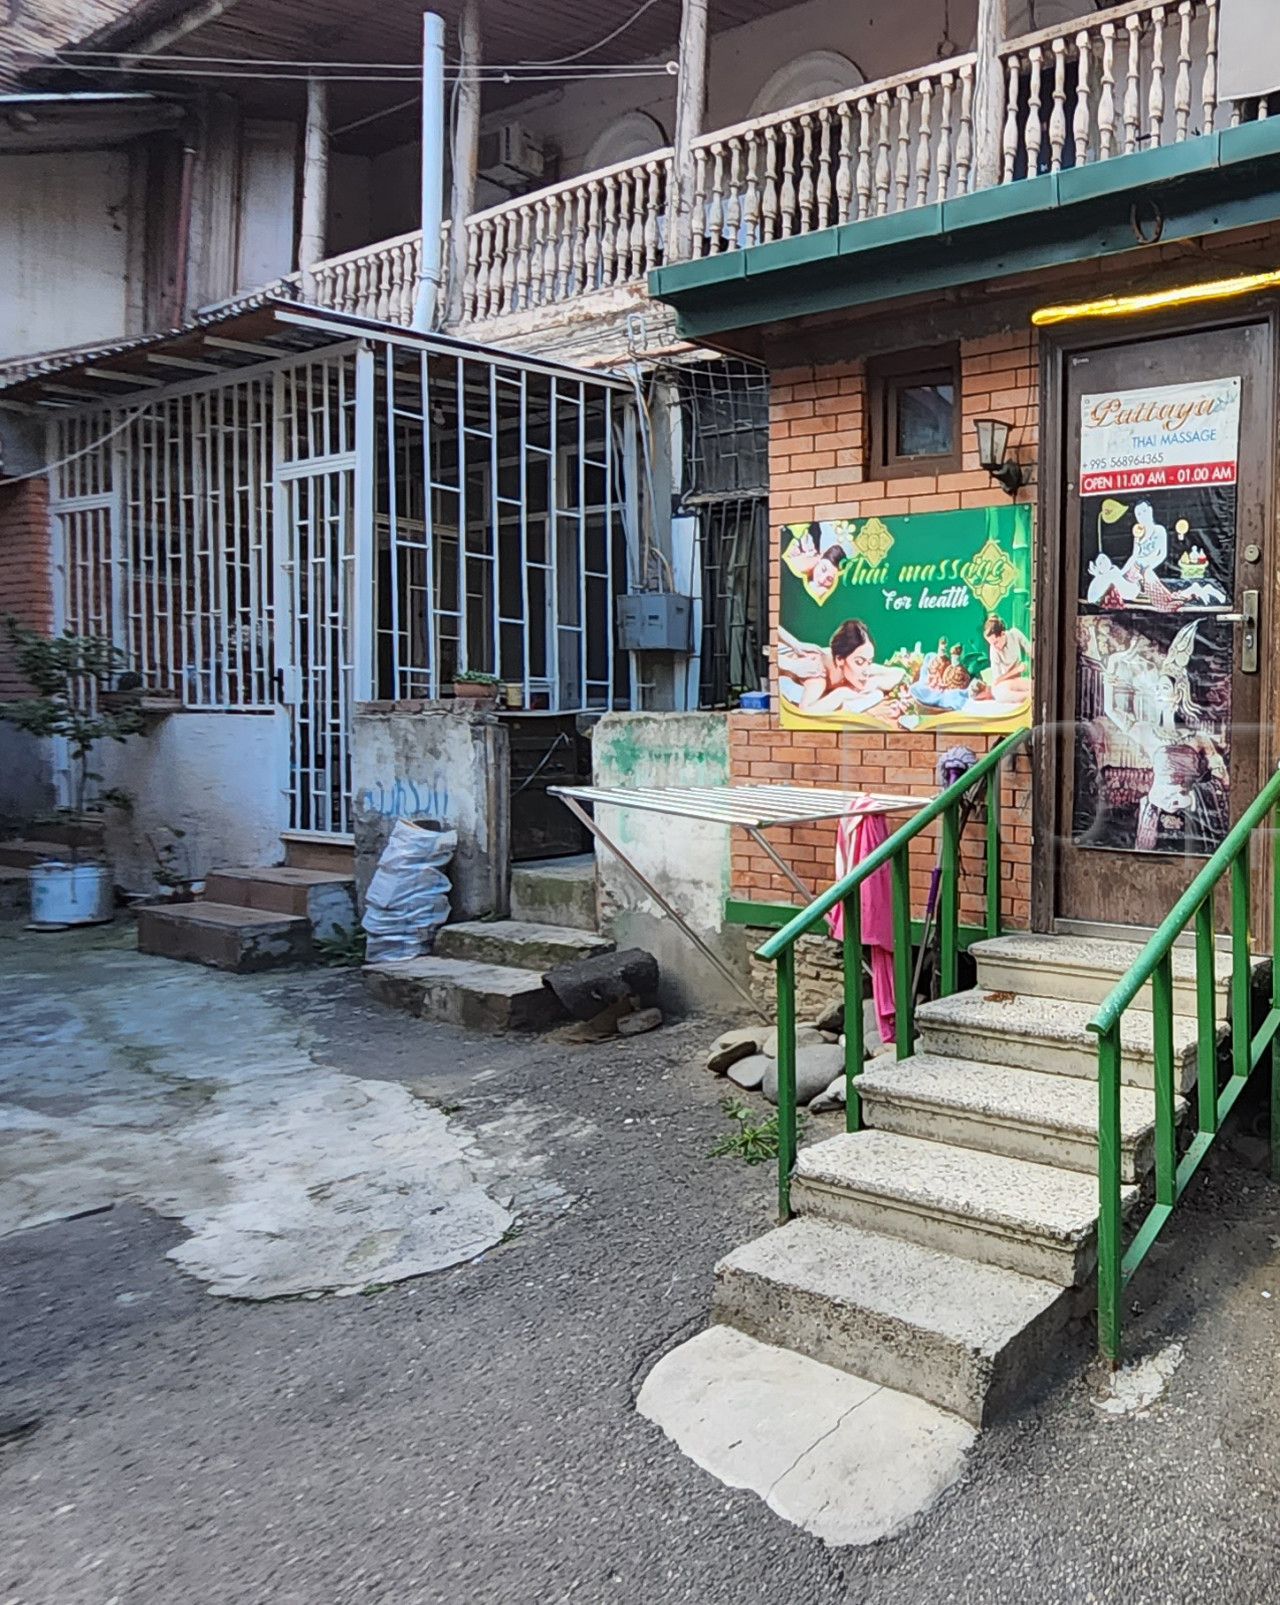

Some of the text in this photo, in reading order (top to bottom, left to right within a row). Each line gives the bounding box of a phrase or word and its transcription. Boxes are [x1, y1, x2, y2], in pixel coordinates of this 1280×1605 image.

[1085, 398, 1216, 431] Pattaya
[1132, 429, 1217, 449] THAI MASSAGE
[1110, 452, 1164, 468] 568964365
[1084, 474, 1113, 491] OPEN
[1116, 472, 1145, 488] 11.00
[1147, 469, 1166, 485] AM
[1177, 467, 1209, 483] 01.00
[1212, 466, 1232, 480] AM
[839, 557, 1005, 587] Thai massage
[882, 585, 969, 610] For health
